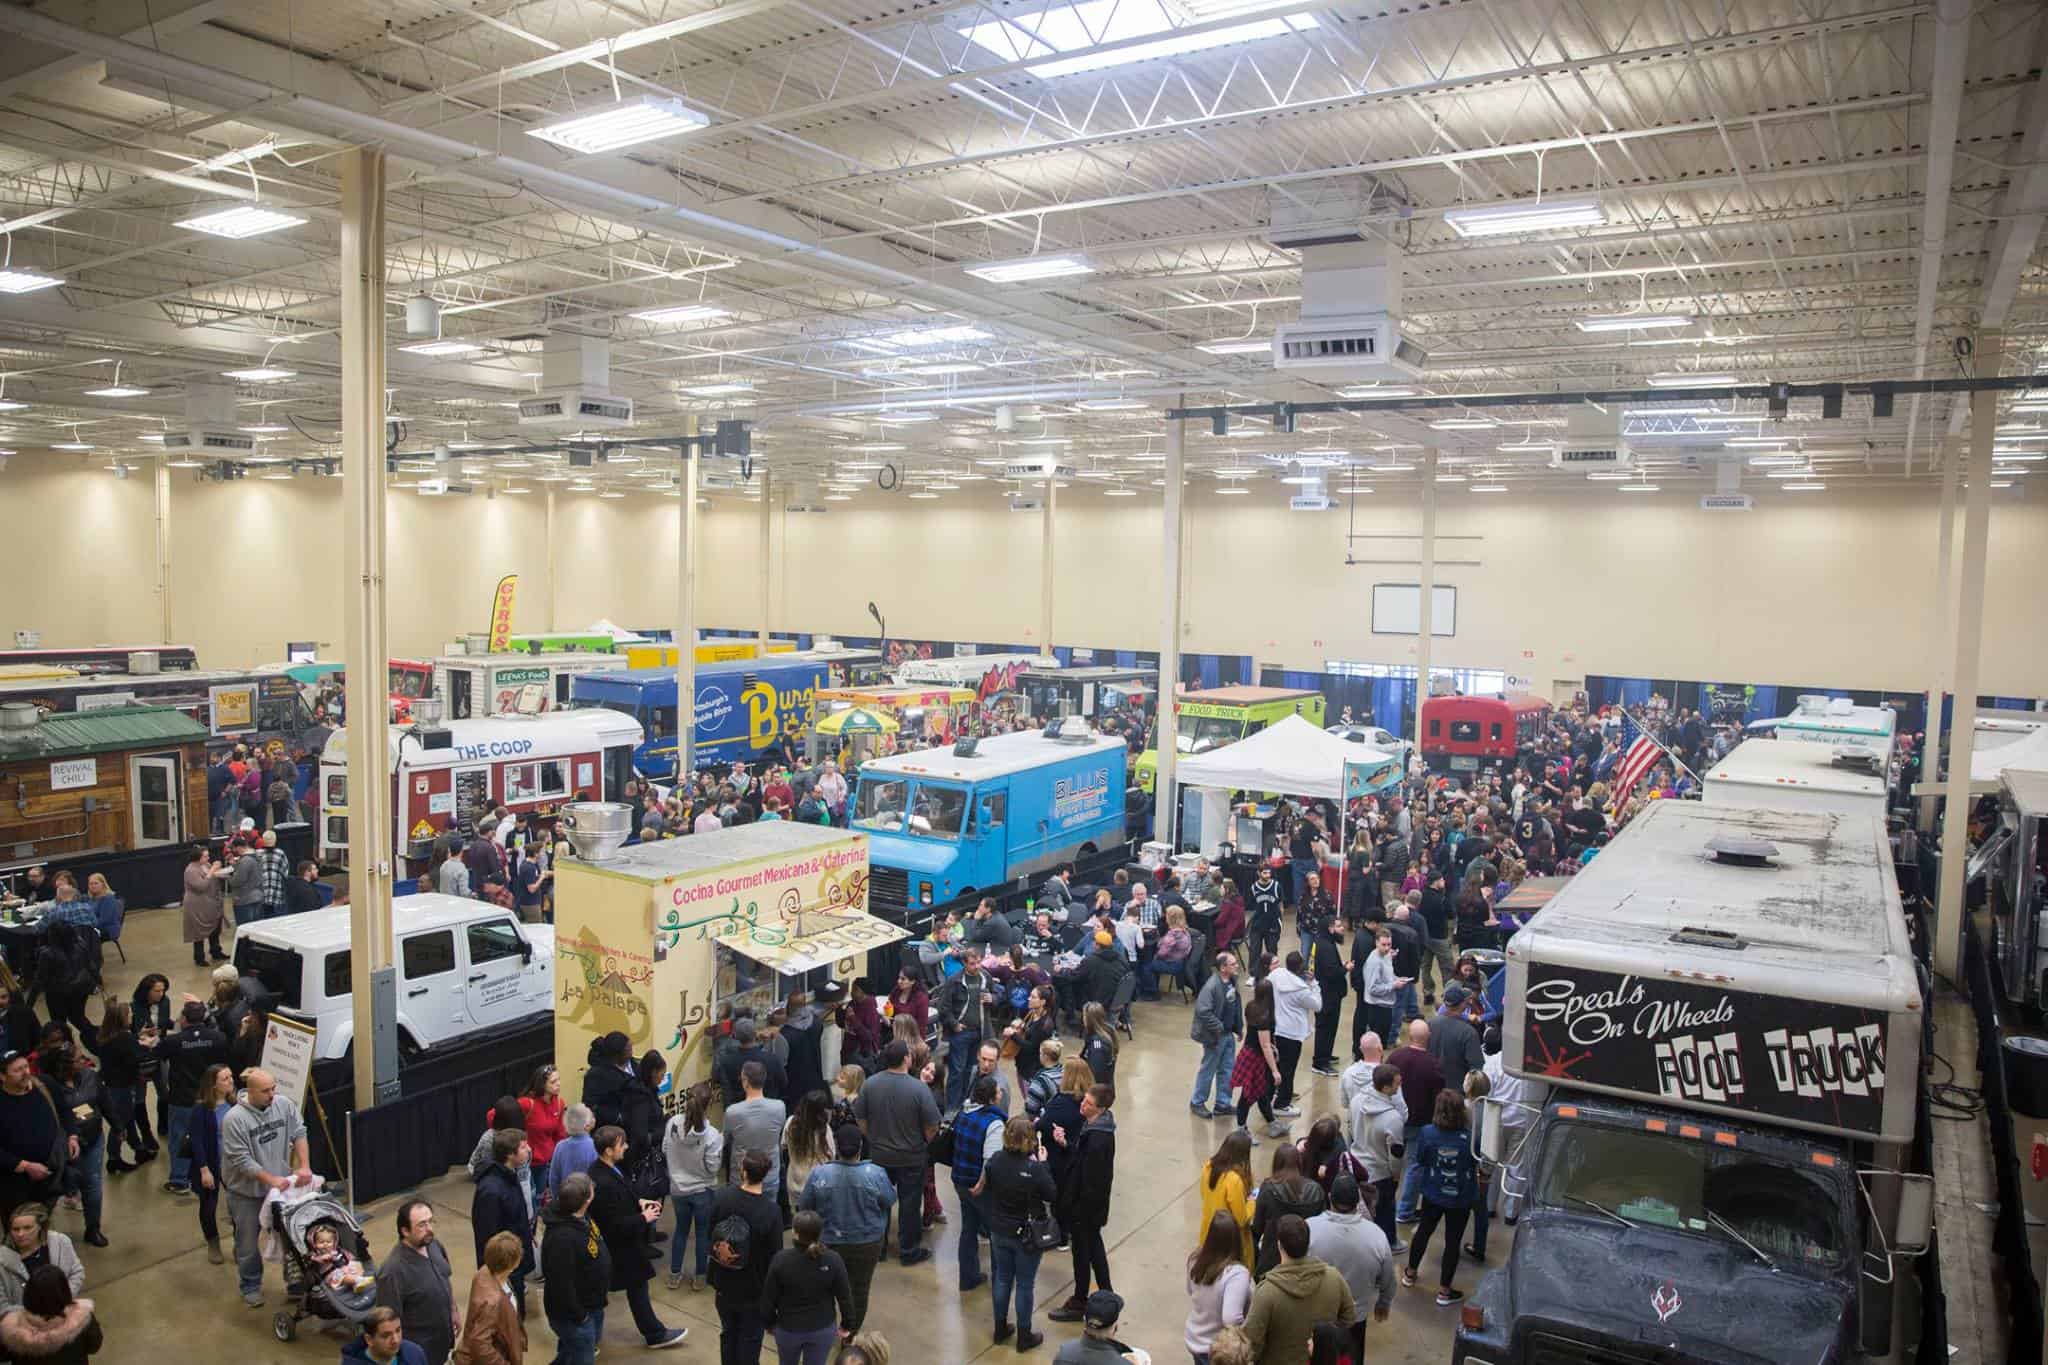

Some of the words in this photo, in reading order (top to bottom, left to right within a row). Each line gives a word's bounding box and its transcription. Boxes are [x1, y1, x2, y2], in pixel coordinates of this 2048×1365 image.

[496, 584, 513, 648] GYROS
[1188, 705, 1212, 715] FOOD
[454, 743, 489, 761] THE
[490, 740, 532, 757] COOP
[54, 763, 93, 776] REVIVAL
[62, 773, 87, 785] CHILI
[1521, 821, 1534, 839] 3
[673, 883, 713, 906] Cocina
[716, 873, 763, 896] Gourmet
[764, 860, 810, 884] Mexicana
[823, 848, 866, 870] Catering
[1526, 975, 1645, 1025] Speal's
[1568, 1012, 1626, 1045] On
[1633, 995, 1736, 1039] Wheels
[1656, 1036, 1744, 1098] FOOD
[1764, 1026, 1885, 1093] TRUCK
